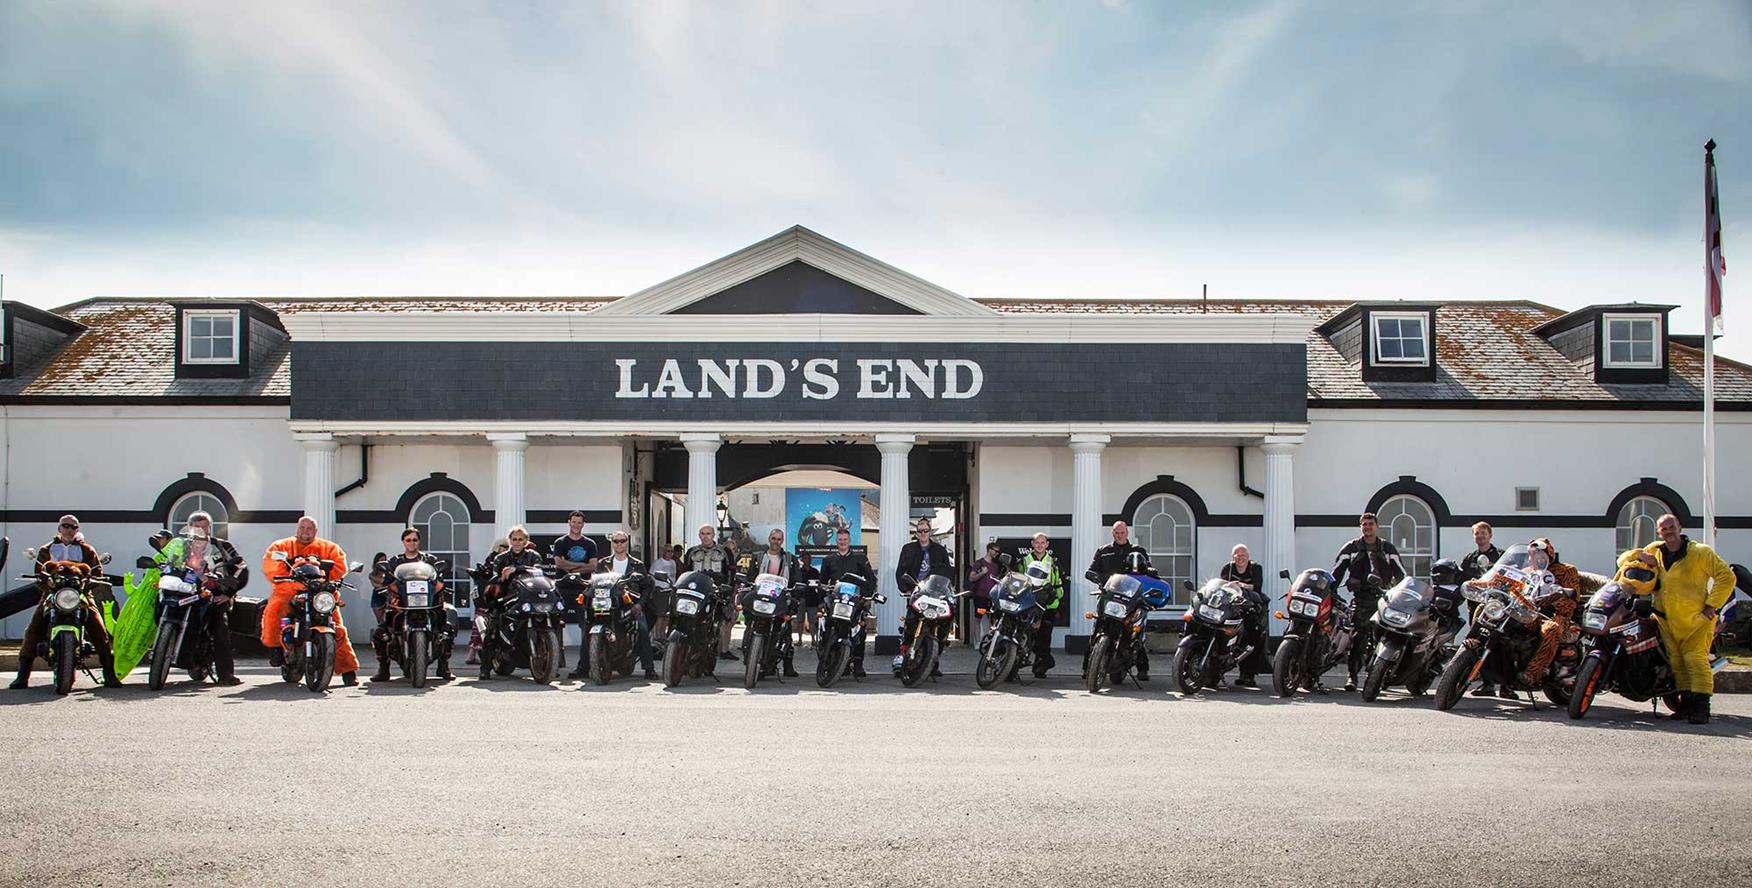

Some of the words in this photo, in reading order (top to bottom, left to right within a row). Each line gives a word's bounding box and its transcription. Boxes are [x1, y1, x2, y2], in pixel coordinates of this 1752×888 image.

[615, 358, 840, 400] LAND'S
[856, 358, 984, 399] END
[912, 496, 951, 504] TOILETS
